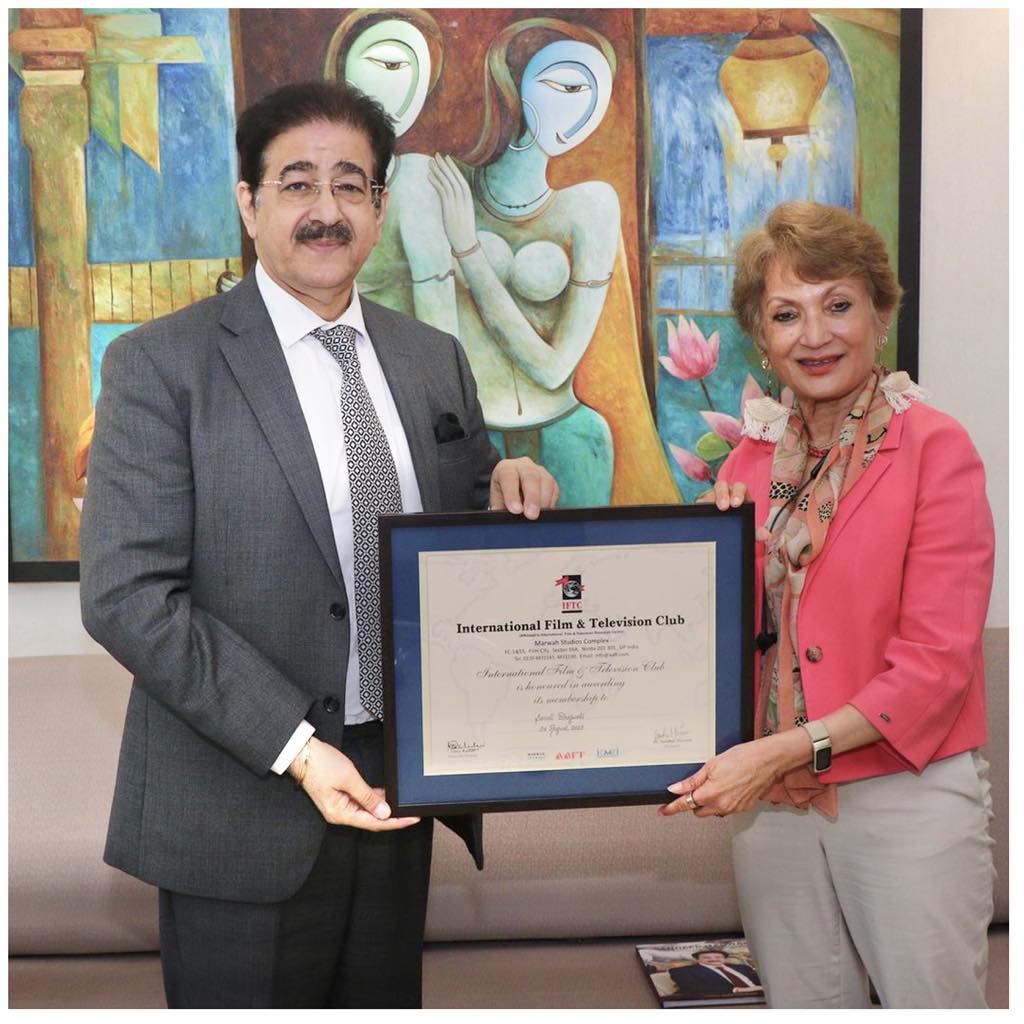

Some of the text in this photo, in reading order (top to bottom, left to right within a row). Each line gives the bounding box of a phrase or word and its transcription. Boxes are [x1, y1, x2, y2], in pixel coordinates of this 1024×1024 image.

[561, 601, 582, 610] IFTC
[456, 614, 685, 634] International Film & Television Club
[476, 664, 547, 678] International
[588, 662, 639, 673] Television
[642, 661, 665, 672] Club
